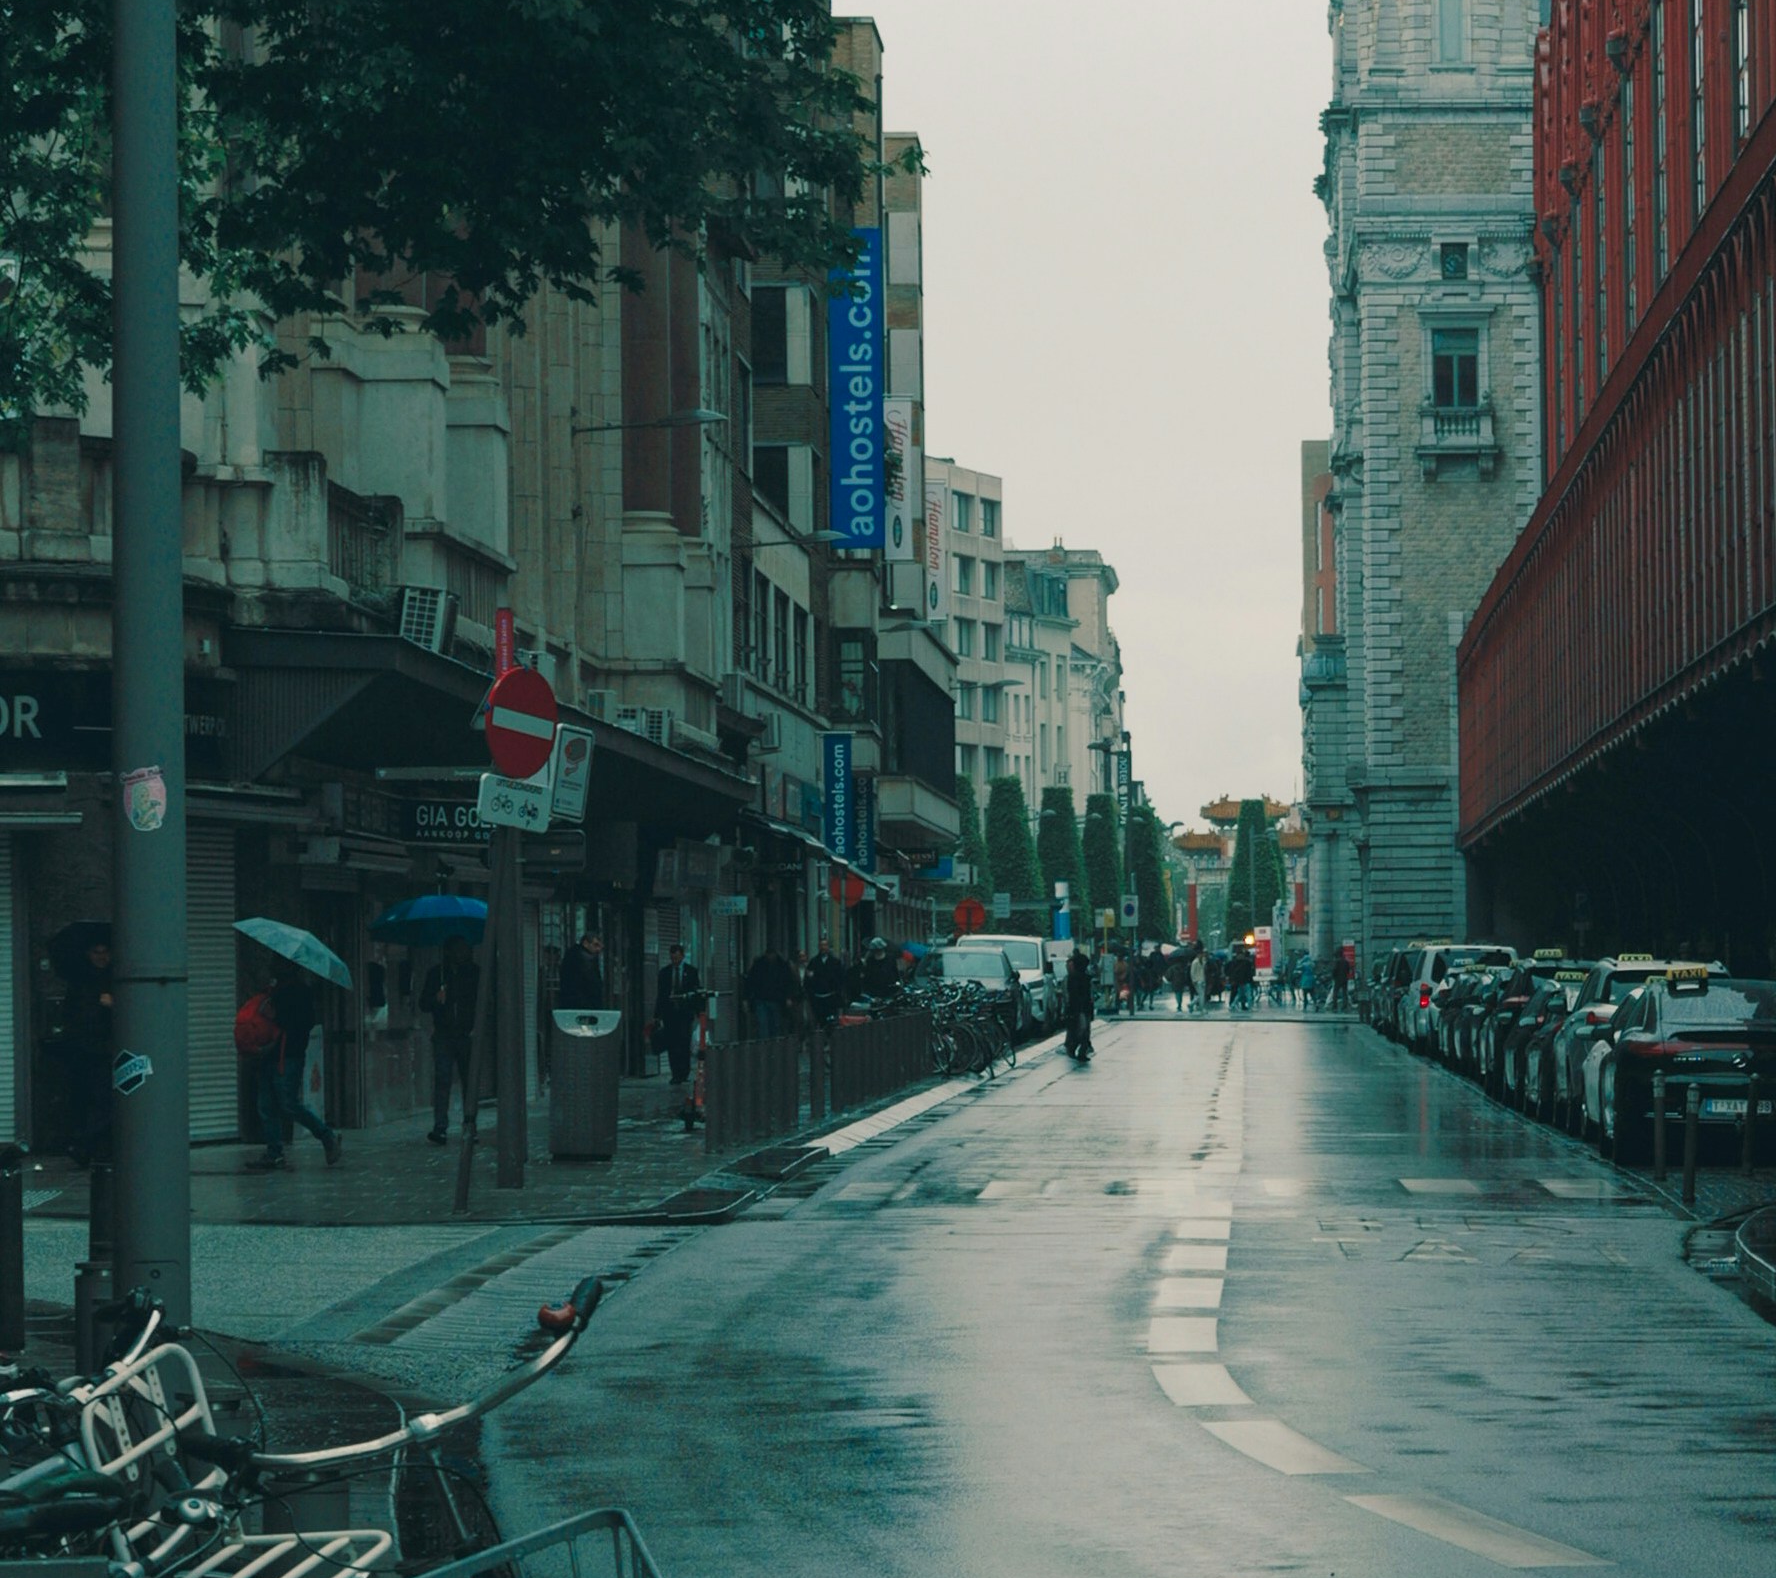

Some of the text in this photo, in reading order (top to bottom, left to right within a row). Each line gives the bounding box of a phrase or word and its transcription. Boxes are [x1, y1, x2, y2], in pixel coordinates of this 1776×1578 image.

[925, 492, 943, 577] Hampton
[832, 744, 846, 855] aohostels.com
[415, 805, 498, 829] GIA GO
[415, 830, 469, 839] AANKOOP
[1673, 968, 1702, 979] TAXI
